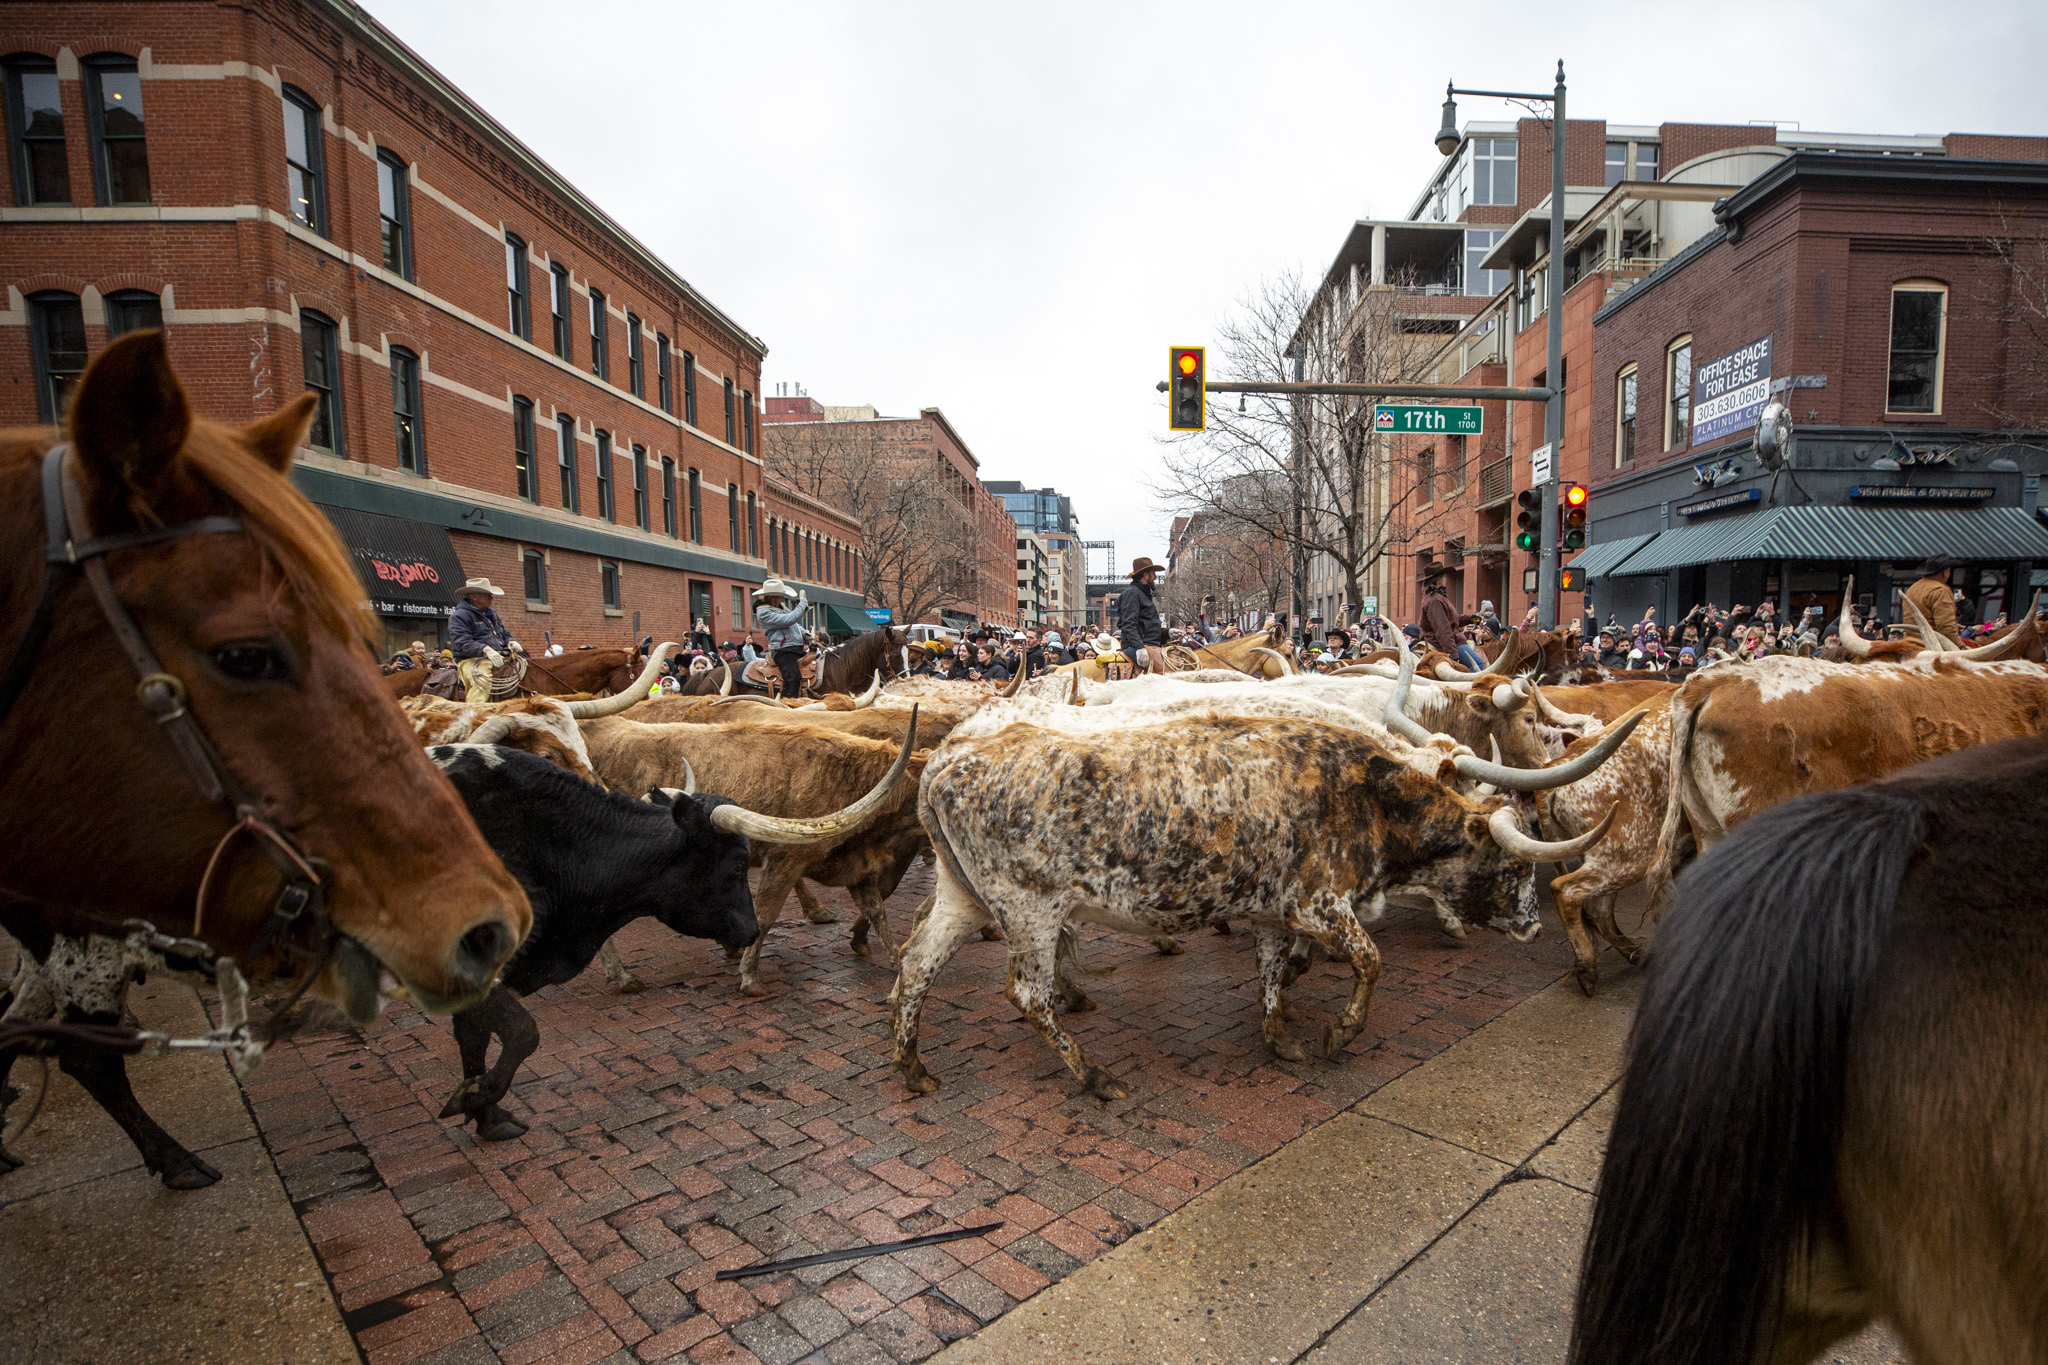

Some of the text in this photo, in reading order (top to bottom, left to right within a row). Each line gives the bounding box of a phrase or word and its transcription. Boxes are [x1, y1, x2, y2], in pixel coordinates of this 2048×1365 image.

[1699, 339, 1769, 385] OFFICE SPACE
[1705, 362, 1759, 399] FOR LEASE
[1697, 382, 1766, 422] 303.630.0606
[1404, 410, 1446, 429] 17th
[1457, 420, 1476, 429] 1700
[1463, 412, 1471, 420] St
[1697, 411, 1742, 437] PLATINUM
[381, 600, 395, 612] bar
[403, 602, 438, 615] ristorante
